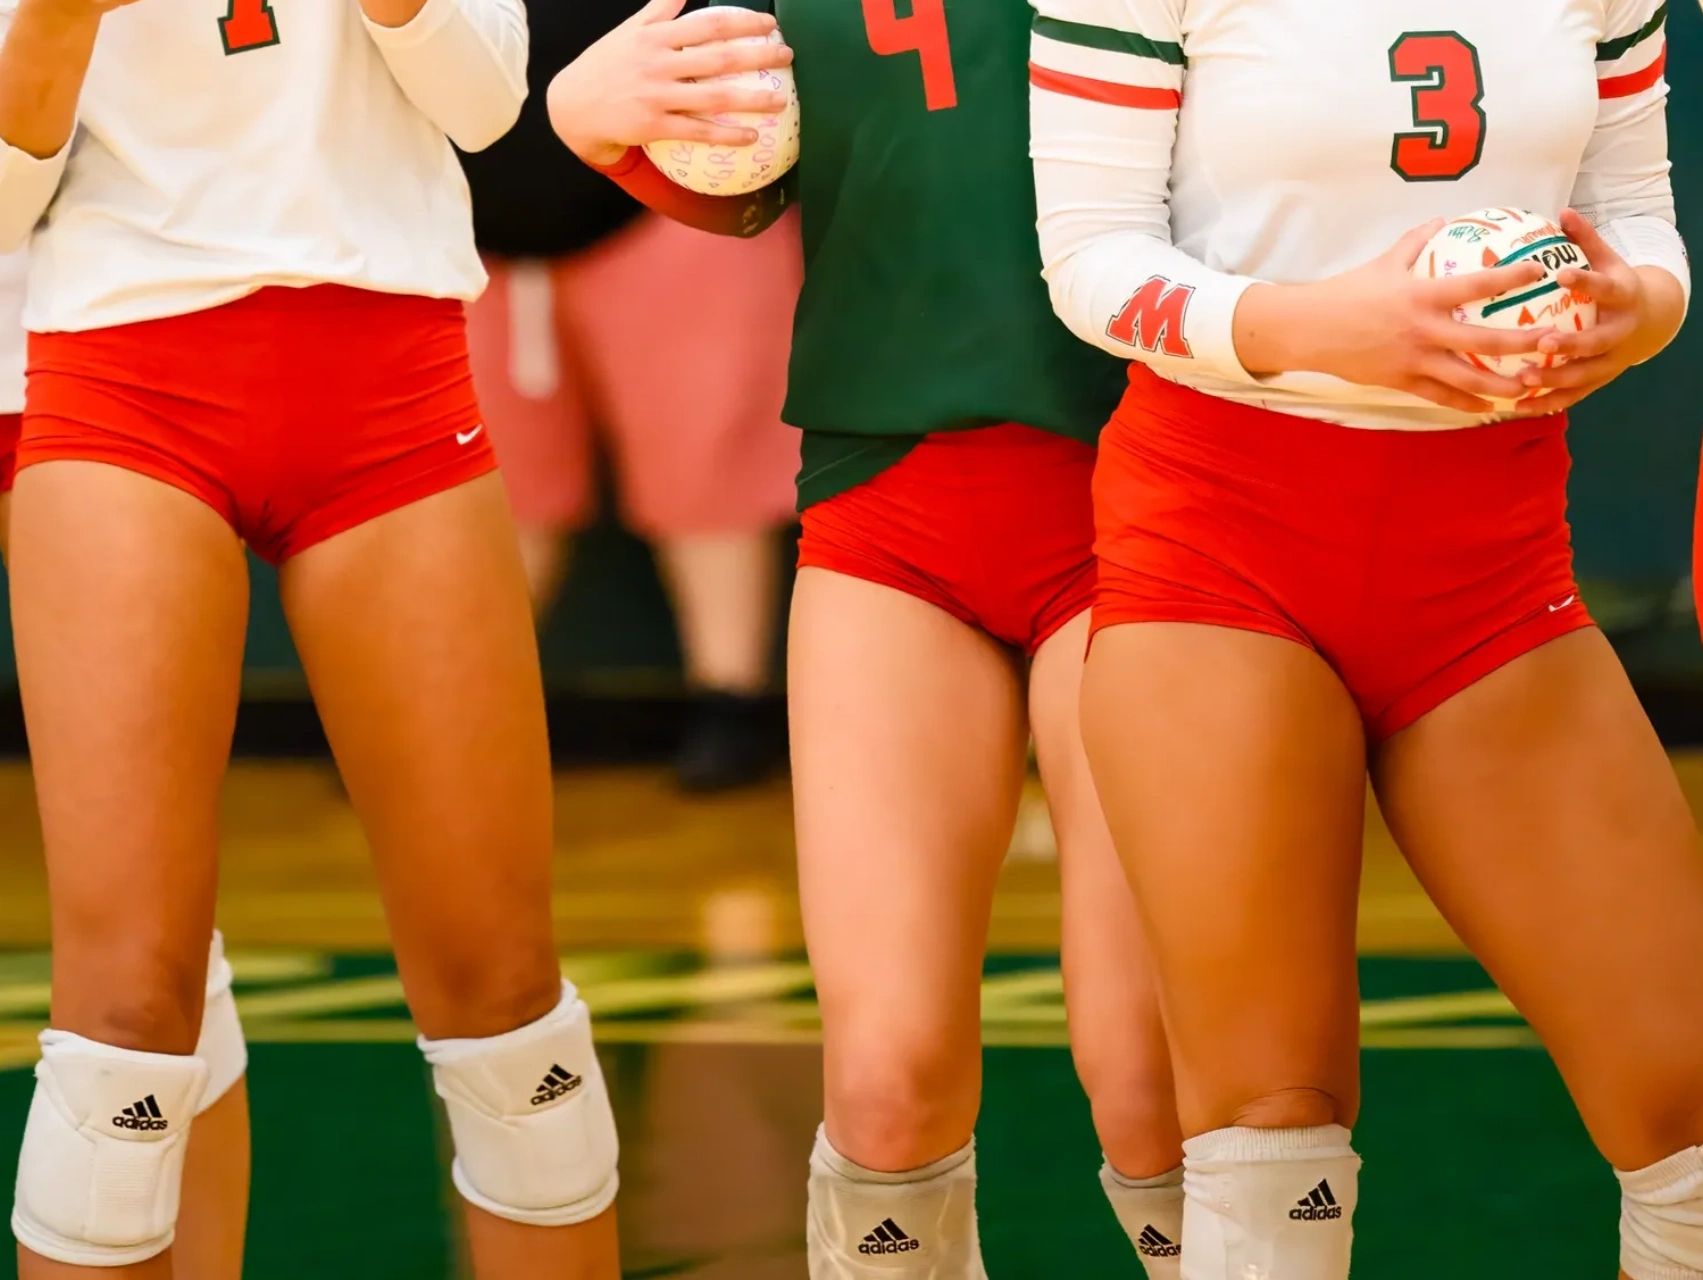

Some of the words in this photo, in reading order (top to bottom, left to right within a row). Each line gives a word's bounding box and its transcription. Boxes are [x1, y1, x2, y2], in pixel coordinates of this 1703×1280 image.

[1388, 30, 1487, 182] 3
[528, 1075, 582, 1106] adidas
[112, 1114, 168, 1131] adidas
[1289, 1205, 1342, 1221] adidas
[858, 1238, 920, 1256] adidas
